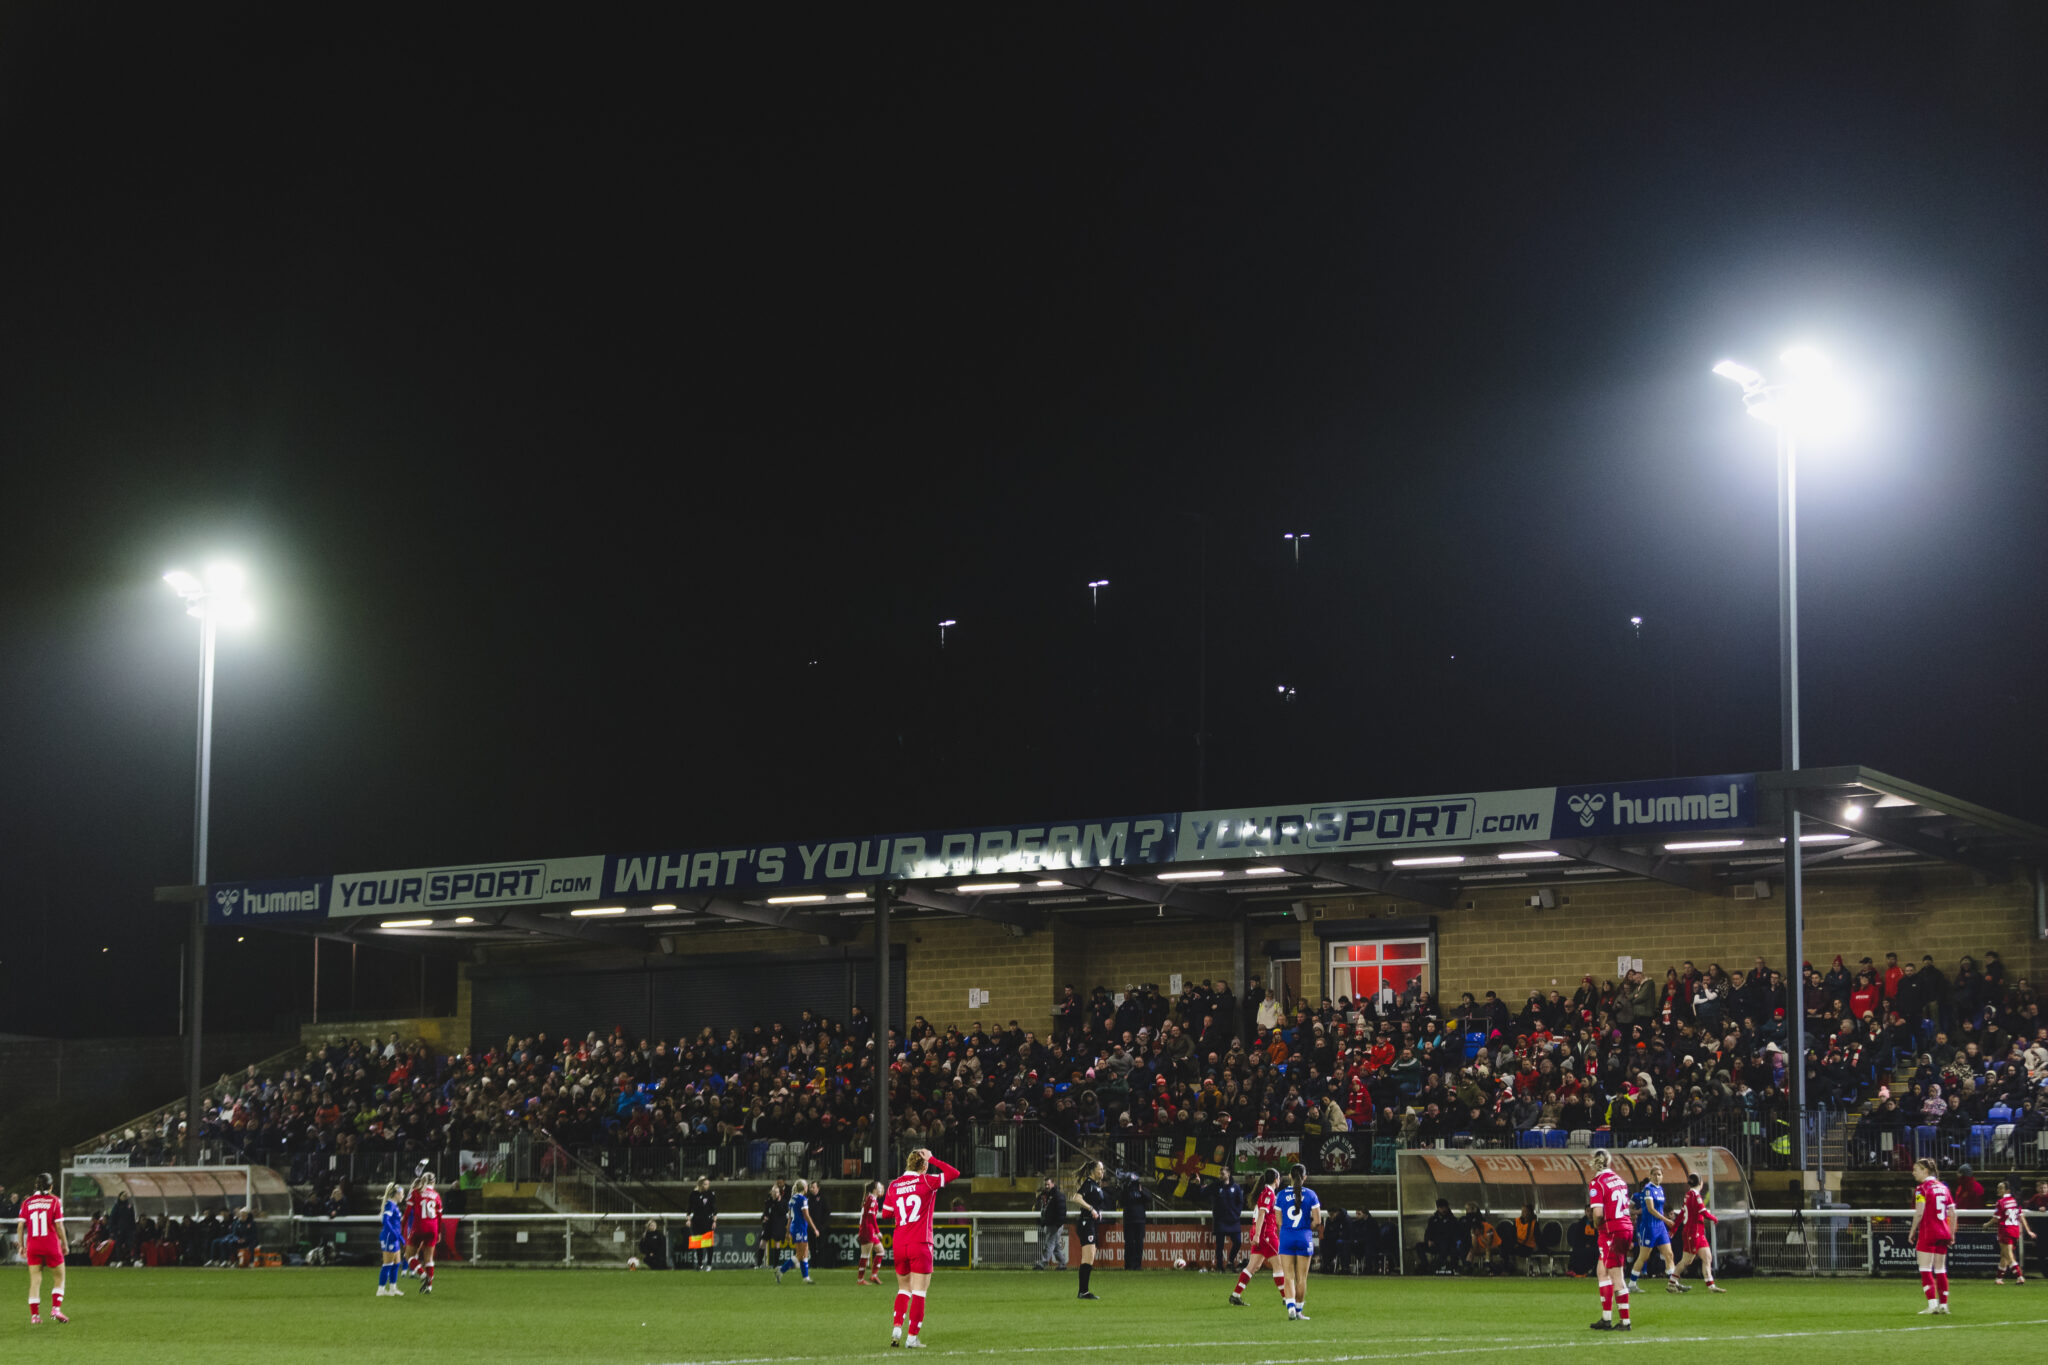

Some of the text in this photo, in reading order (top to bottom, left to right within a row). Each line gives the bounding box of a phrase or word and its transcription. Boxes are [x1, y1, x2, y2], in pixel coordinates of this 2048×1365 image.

[1613, 784, 1738, 825] hummel
[614, 819, 1163, 893] WHAT'S YOUR DREAM?
[243, 883, 319, 914] hummel
[896, 1194, 922, 1226] 12
[1287, 1205, 1303, 1228] 9
[1935, 1195, 1947, 1221] 5
[30, 1211, 48, 1237] 11
[1143, 1231, 1168, 1244] DRAN
[1169, 1231, 1202, 1244] TROPHY
[1199, 1248, 1228, 1262] ADRN
